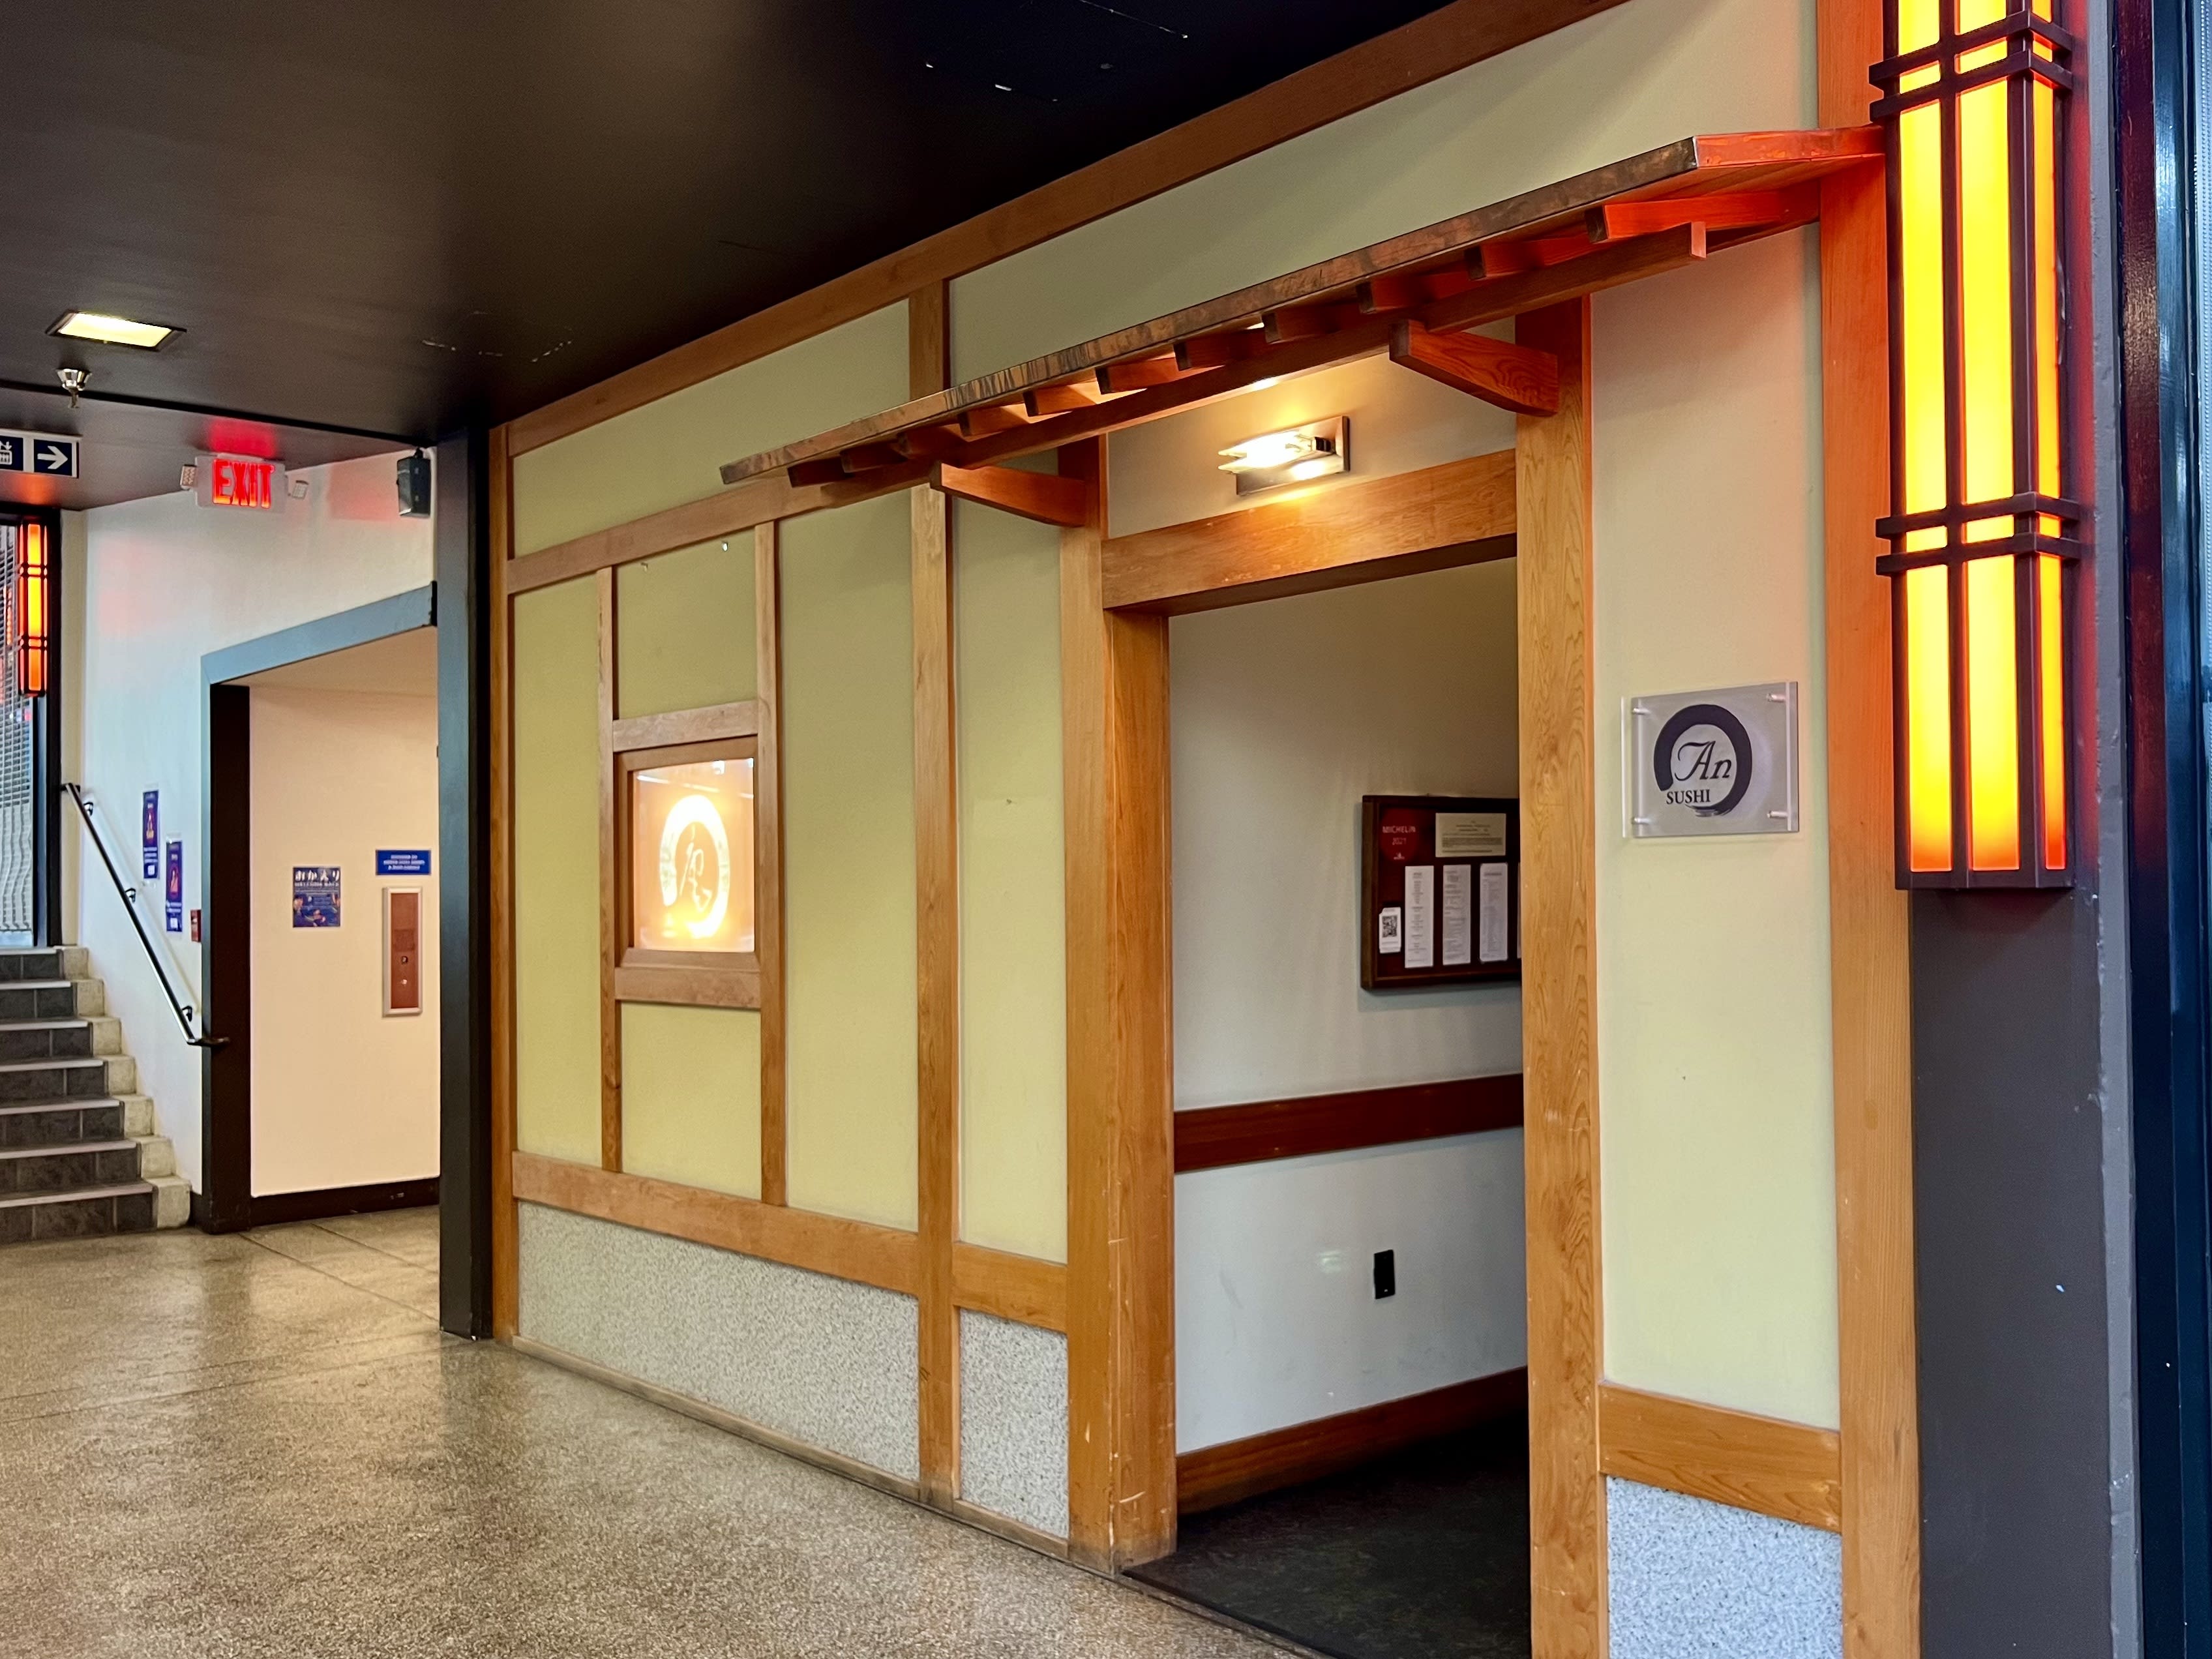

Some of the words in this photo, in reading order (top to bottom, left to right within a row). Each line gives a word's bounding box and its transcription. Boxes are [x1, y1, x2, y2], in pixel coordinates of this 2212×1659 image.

[213, 459, 275, 509] EXIT
[1675, 741, 1731, 781] An
[1666, 789, 1711, 805] SUSHI
[1382, 825, 1416, 833] MICHELIN
